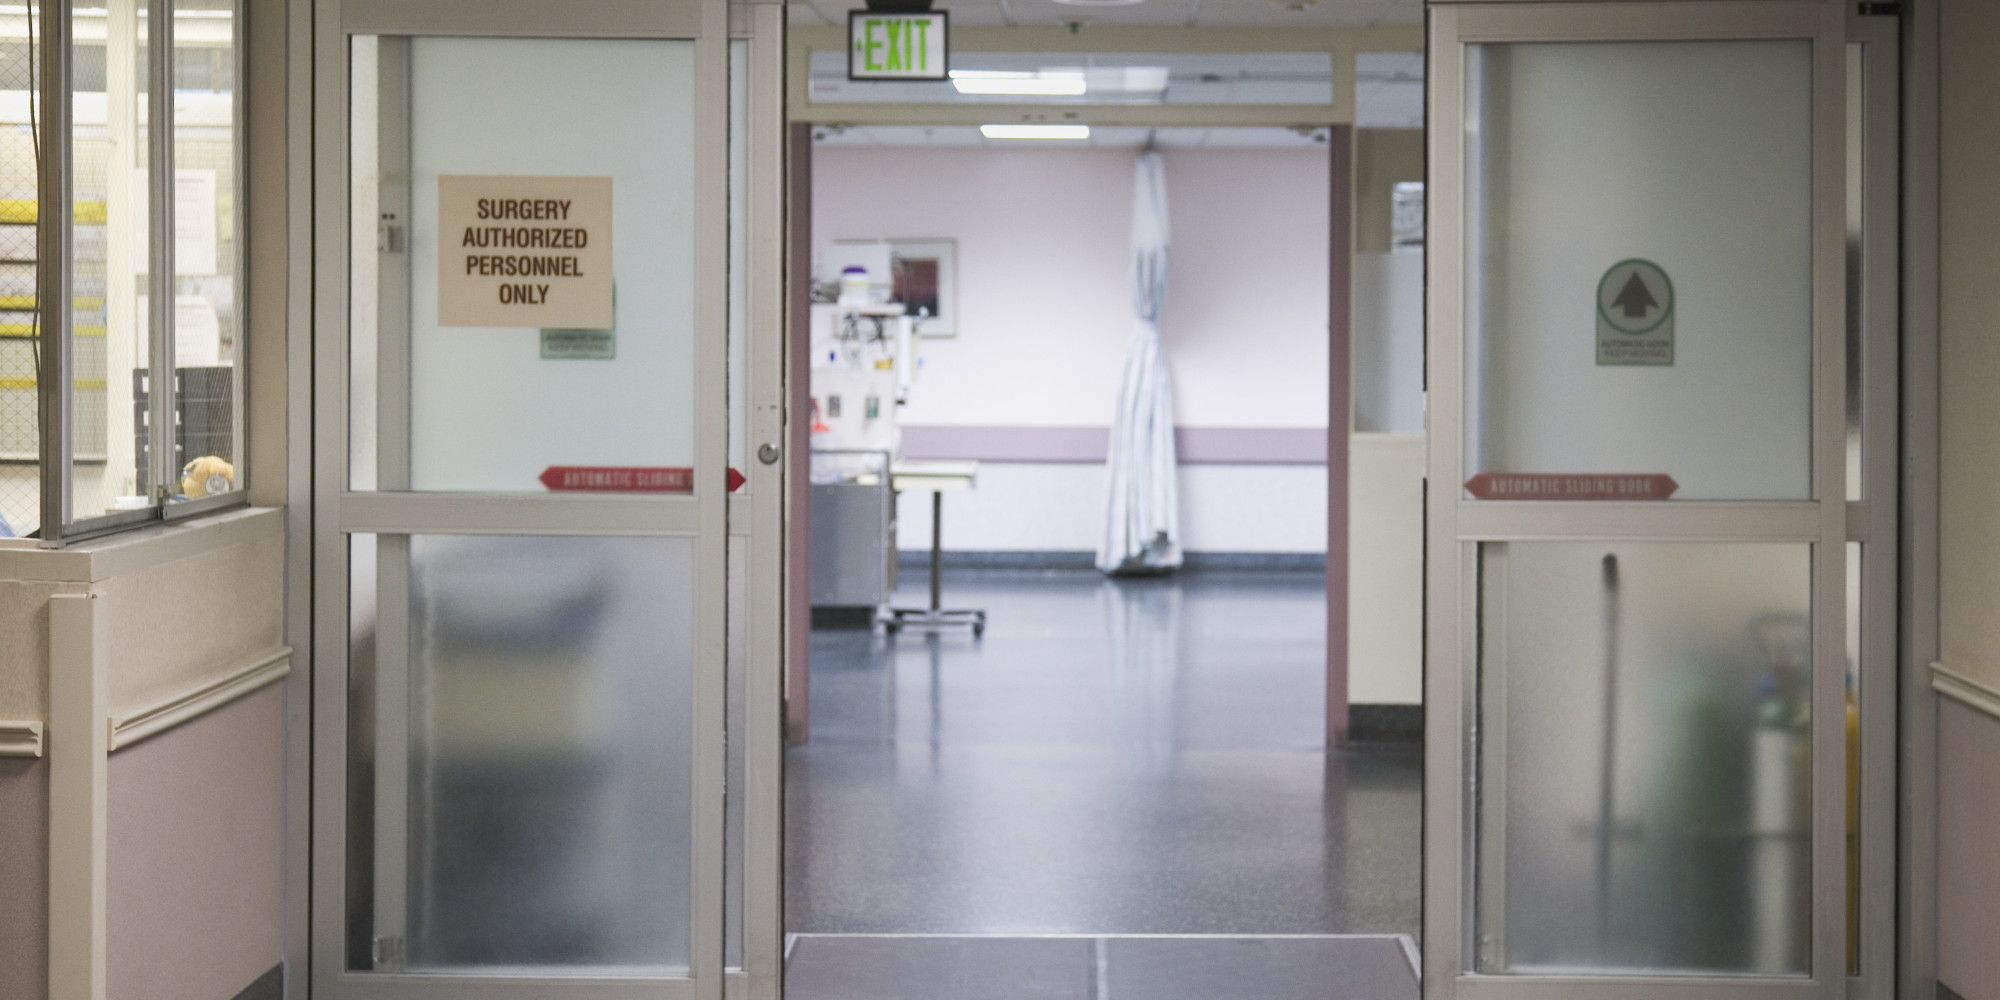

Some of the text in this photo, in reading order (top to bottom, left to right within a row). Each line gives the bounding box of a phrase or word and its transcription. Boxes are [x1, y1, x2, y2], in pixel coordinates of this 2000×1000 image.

[865, 19, 931, 71] EXIT
[477, 198, 571, 220] SURGERY
[462, 227, 588, 249] AUTHORIZED
[466, 255, 584, 277] PERSONNEL
[499, 283, 550, 305] ONLY
[563, 471, 632, 487] AUTOMATIC
[635, 472, 684, 488] SLIDING
[1490, 478, 1652, 494] AUTOMATIC SLIDING DOOR
